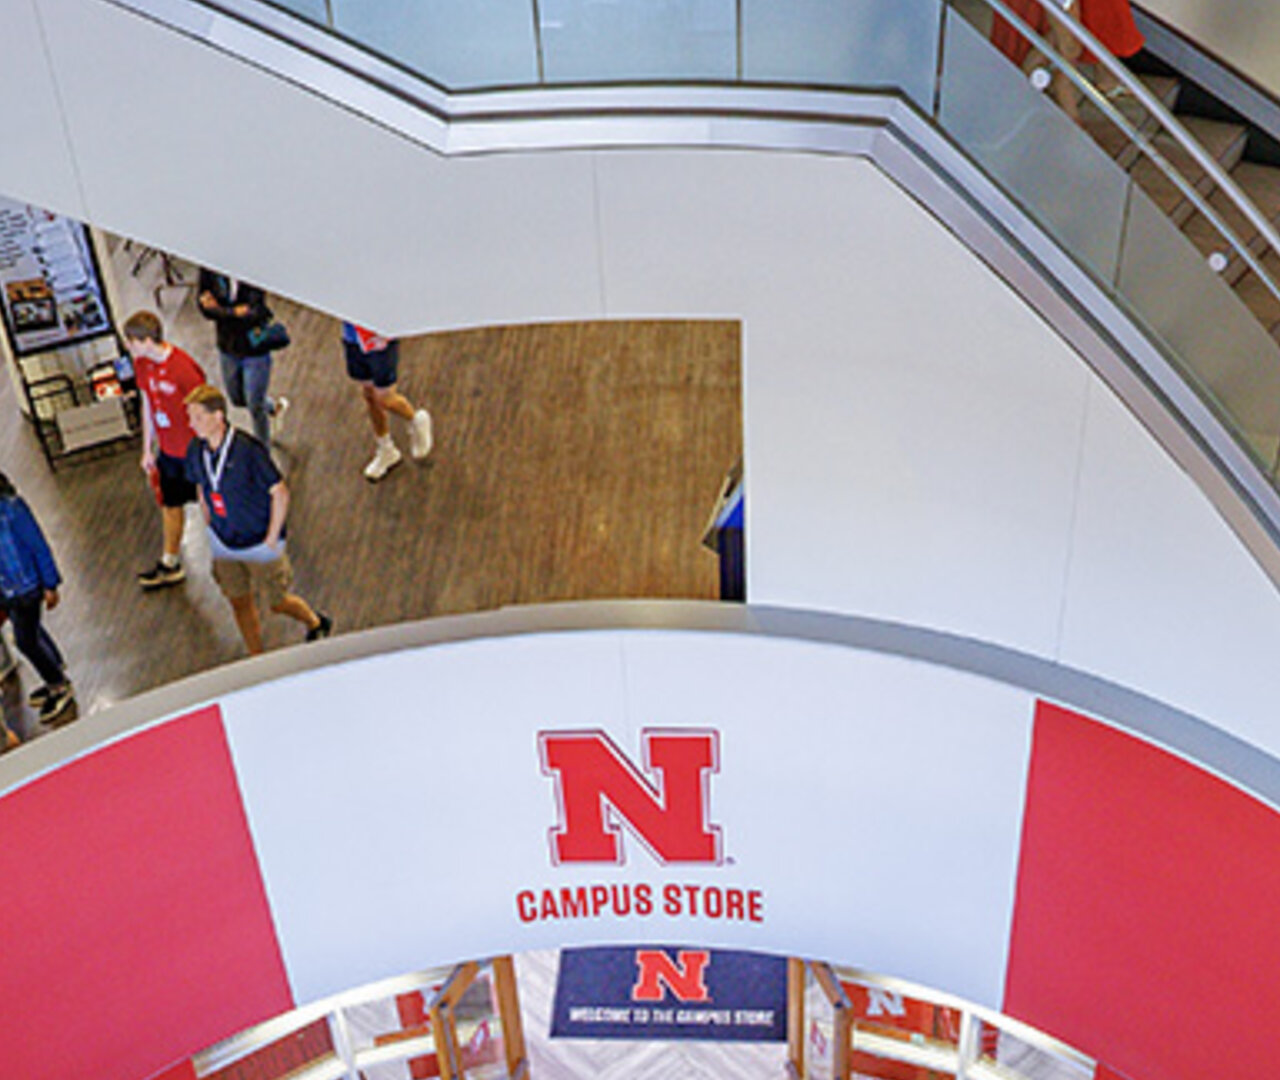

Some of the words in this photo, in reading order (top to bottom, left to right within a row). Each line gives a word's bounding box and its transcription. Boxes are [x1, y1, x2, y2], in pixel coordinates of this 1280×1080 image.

[538, 728, 723, 866] N
[517, 884, 653, 923] CAMPUS
[664, 884, 764, 923] STORE
[633, 950, 709, 1001] N
[570, 1007, 629, 1024] WELCOME
[632, 1008, 649, 1024] TO
[653, 1008, 674, 1025] THE
[677, 1008, 731, 1026] CAMPUS
[735, 1010, 774, 1026] STORE
